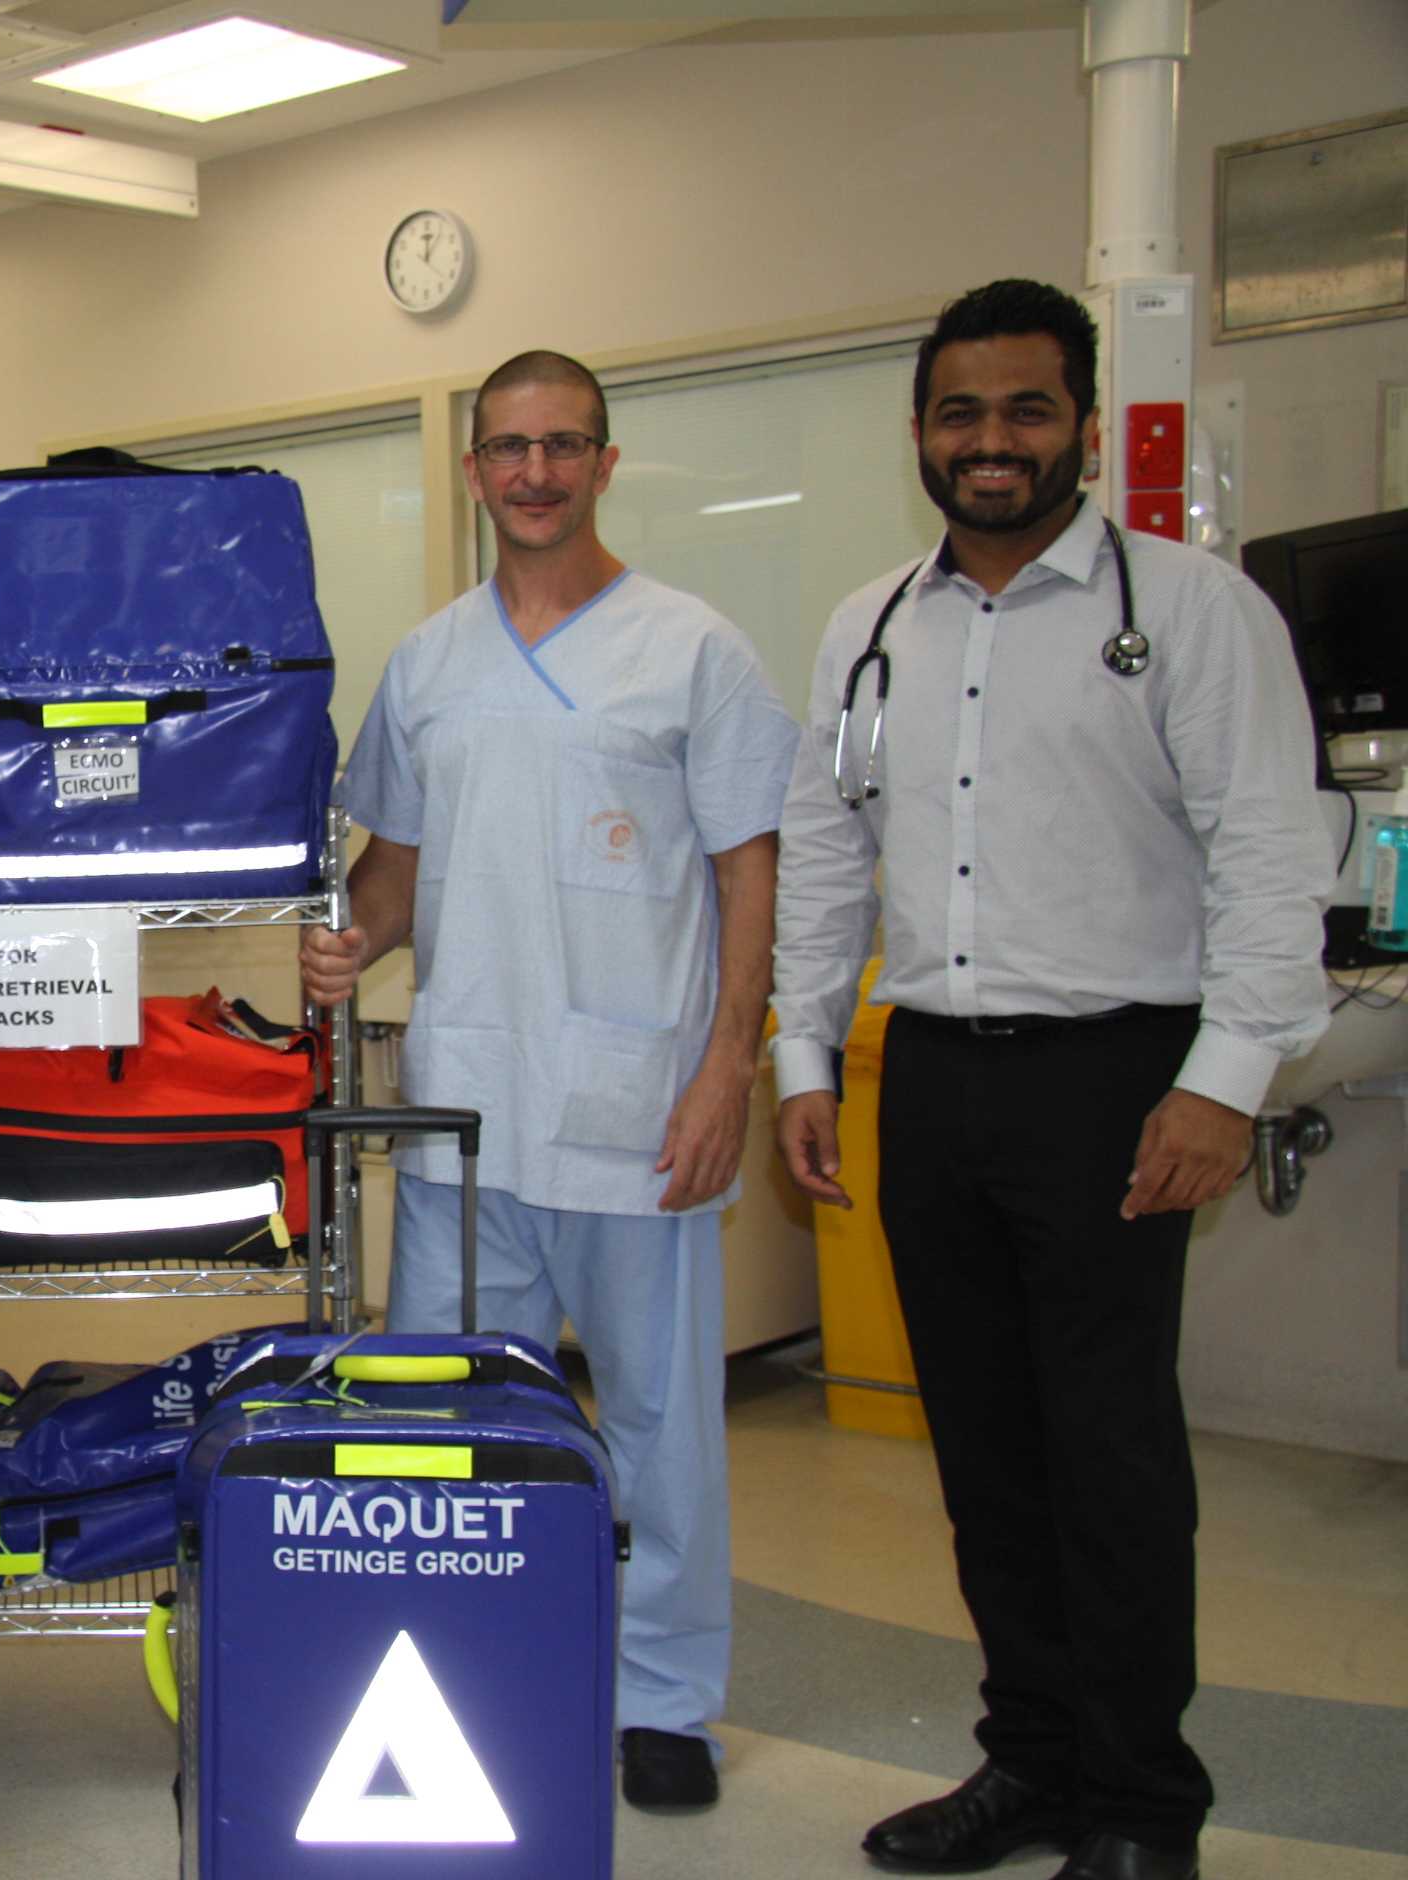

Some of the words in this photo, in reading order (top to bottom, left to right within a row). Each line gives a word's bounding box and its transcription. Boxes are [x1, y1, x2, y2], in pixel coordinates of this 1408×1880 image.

[70, 753, 124, 769] ECMO
[152, 1380, 195, 1430] Life
[273, 1494, 526, 1544] MAQUET
[273, 1547, 408, 1575] GETINGE
[415, 1551, 526, 1576] GROUP
